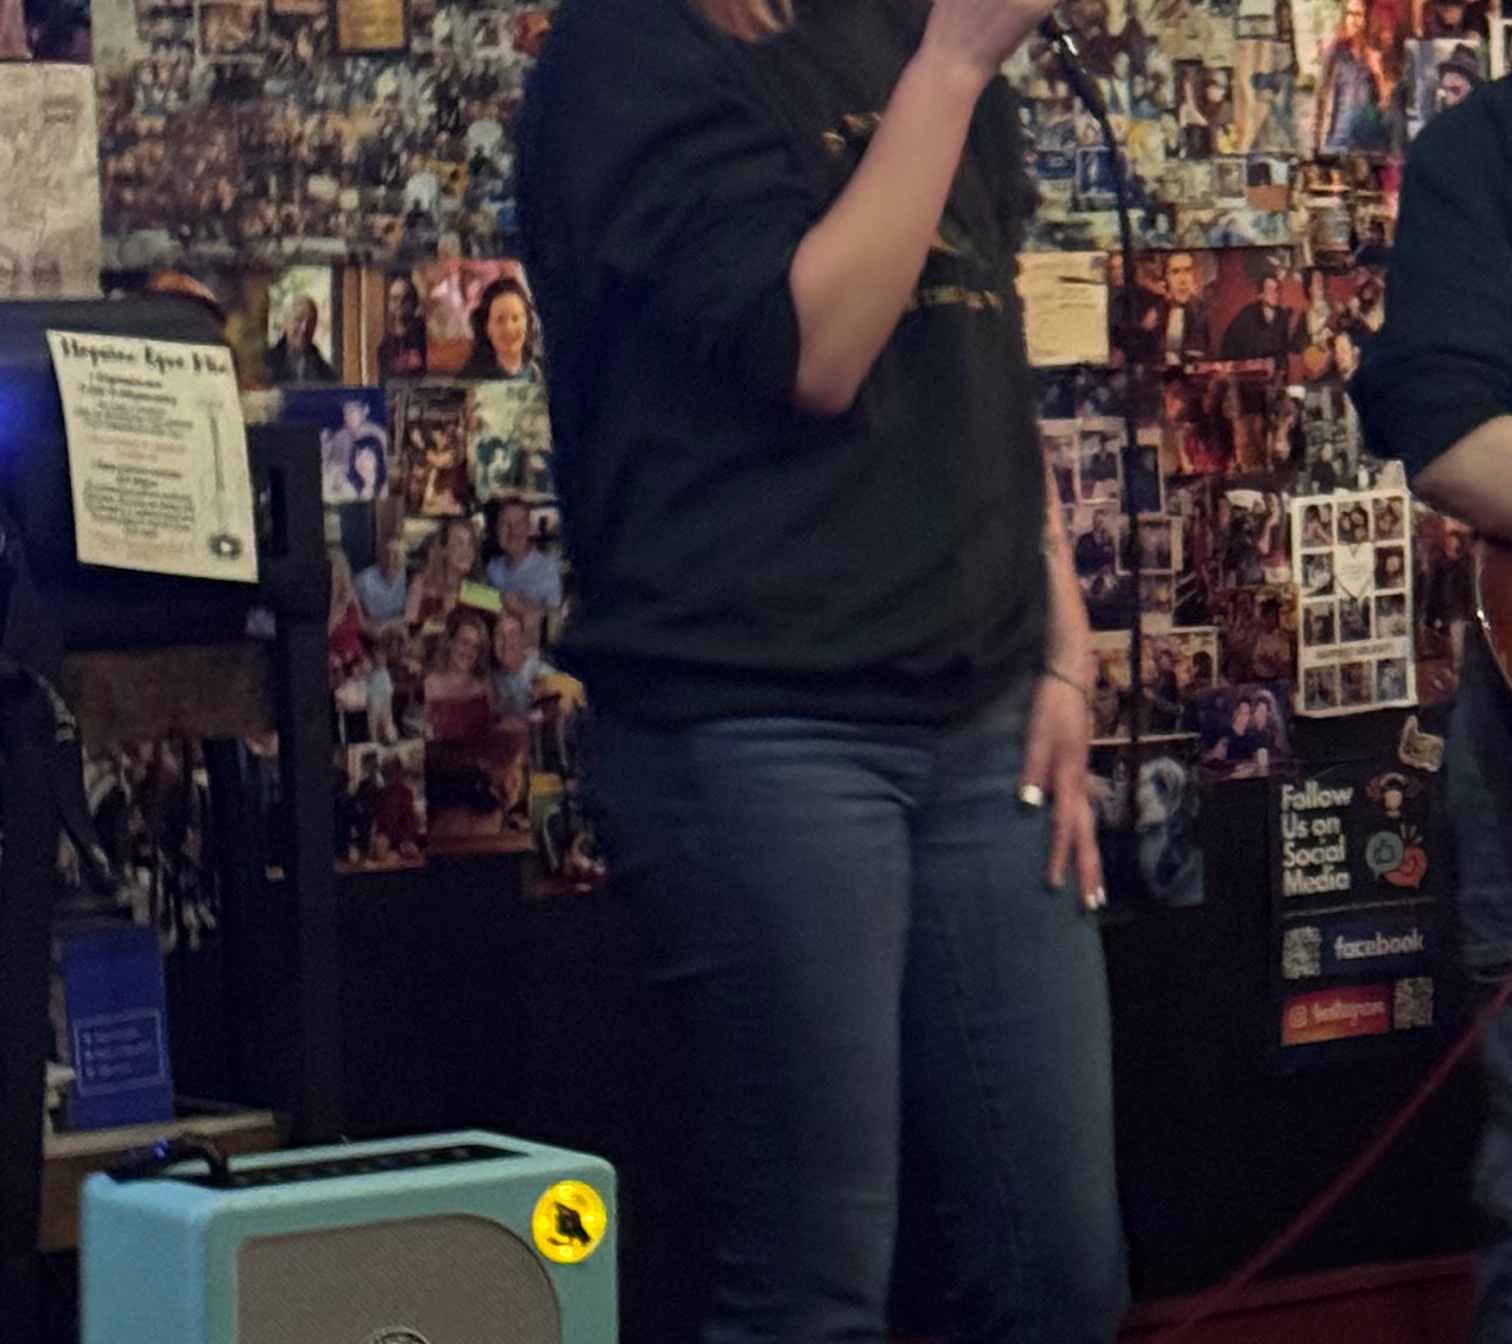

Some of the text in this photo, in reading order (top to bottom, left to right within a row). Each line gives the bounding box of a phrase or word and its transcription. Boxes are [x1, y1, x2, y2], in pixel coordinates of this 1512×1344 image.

[1281, 781, 1354, 812] Follow
[1281, 813, 1342, 840] Us on
[1282, 834, 1347, 868] Social
[1283, 865, 1351, 897] Media
[1334, 927, 1425, 960] facebook
